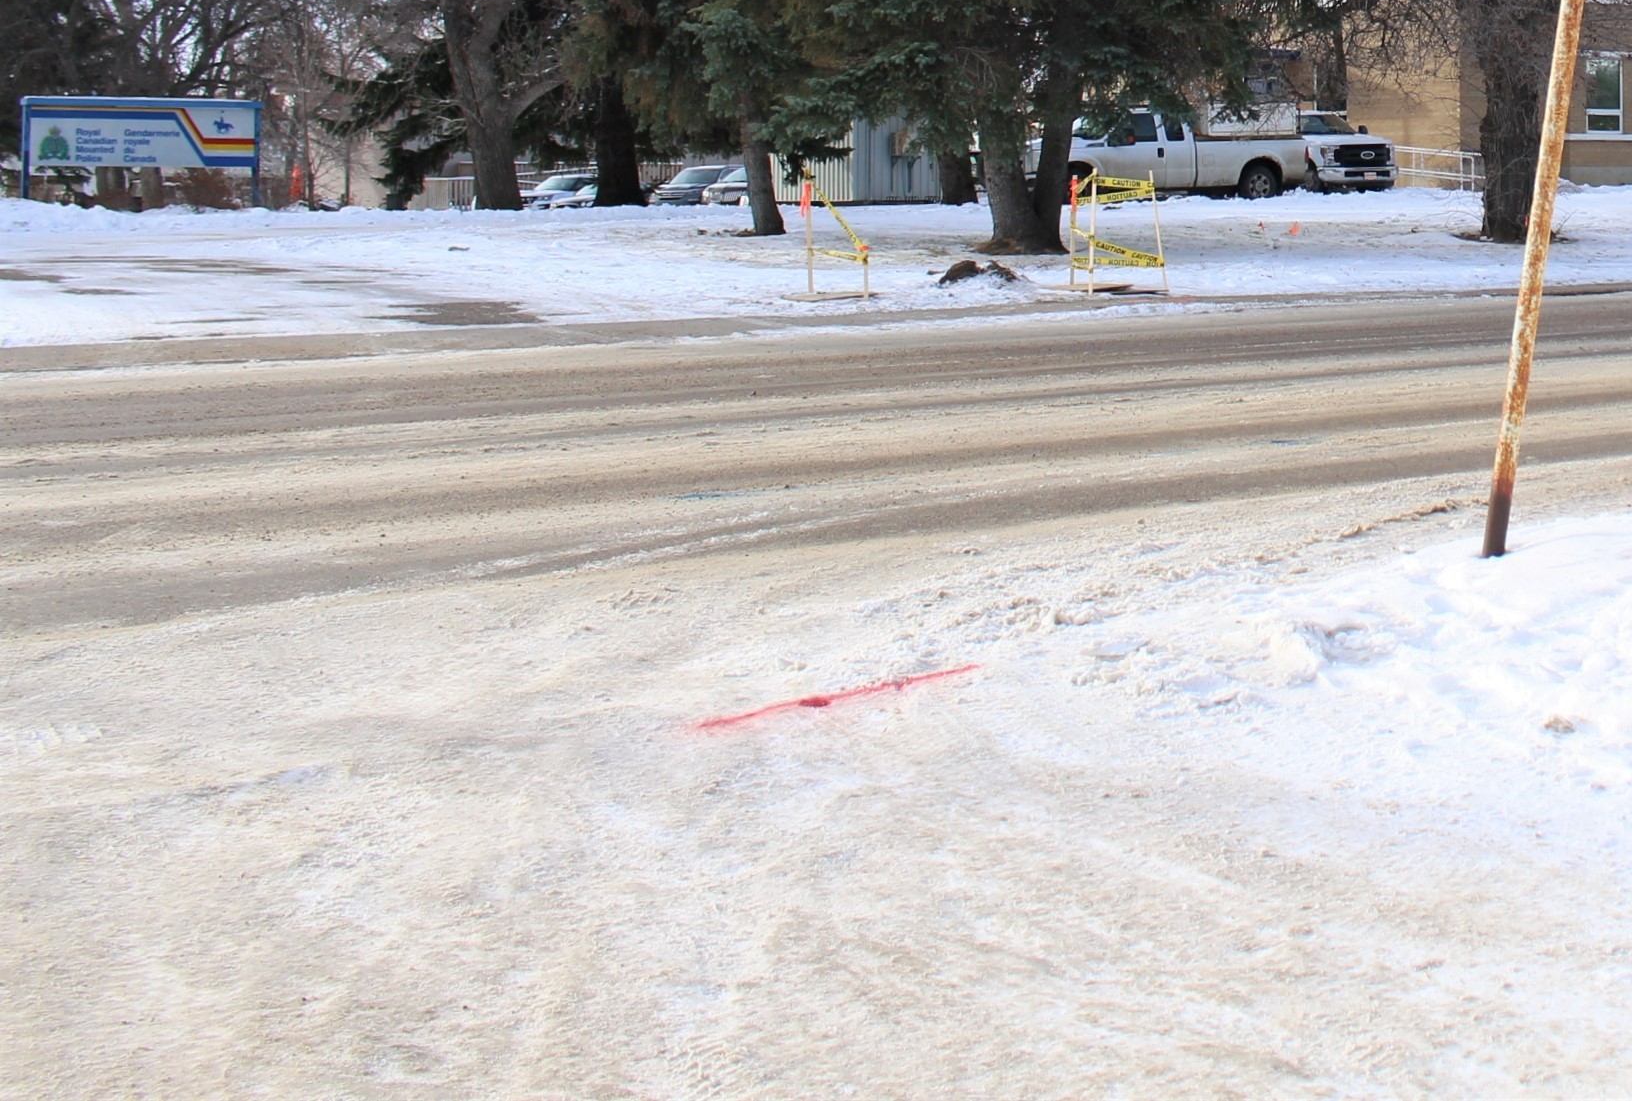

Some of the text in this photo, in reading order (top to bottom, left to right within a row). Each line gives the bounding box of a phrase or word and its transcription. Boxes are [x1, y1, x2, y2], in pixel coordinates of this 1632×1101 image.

[76, 128, 101, 137] Royal
[124, 129, 180, 138] Gendarmerie
[76, 137, 117, 145] Canadian
[124, 139, 151, 147] royale
[76, 146, 115, 154] Mounted
[76, 154, 103, 162] Police
[124, 155, 157, 163] Canada
[1112, 179, 1141, 187] CAUTION
[1096, 241, 1158, 262] CAUTION CAUTION
